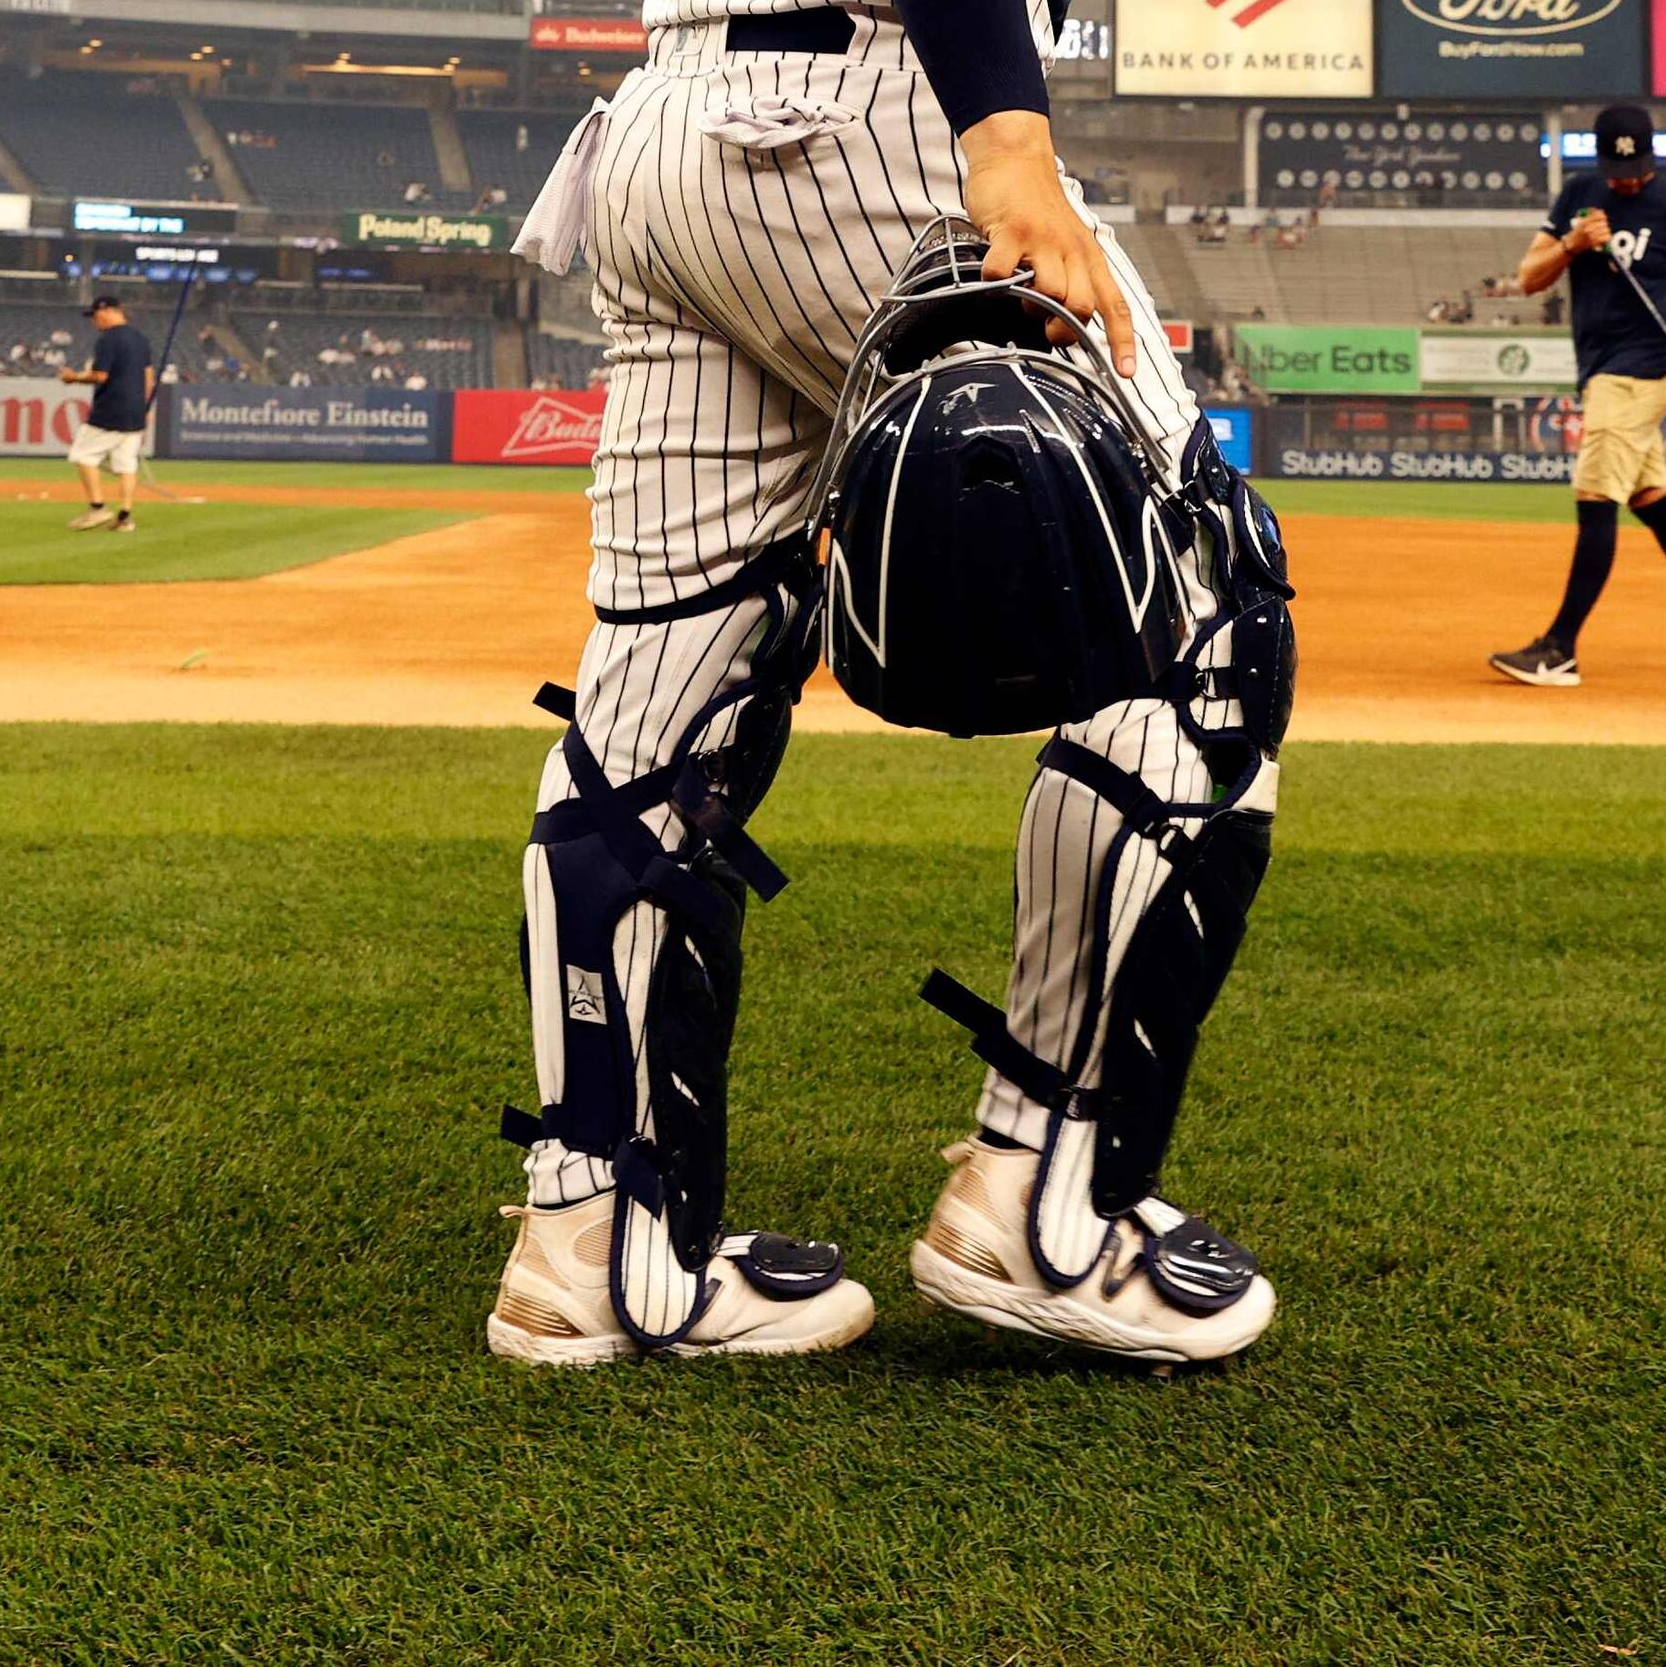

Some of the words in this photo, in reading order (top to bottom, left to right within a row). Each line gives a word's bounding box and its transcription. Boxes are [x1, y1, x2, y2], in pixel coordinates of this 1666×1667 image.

[1123, 51, 1194, 70] BANK
[1203, 51, 1235, 71] OF
[1244, 52, 1364, 72] AMERICA
[359, 213, 426, 241] Poland
[426, 215, 492, 247] Spring
[1331, 345, 1412, 375] Eats
[181, 397, 321, 427] Montefiore
[327, 401, 429, 428] Einstein
[1282, 450, 1383, 477] StubHub
[1390, 451, 1493, 479] StubHub
[1501, 453, 1575, 480] StubH
